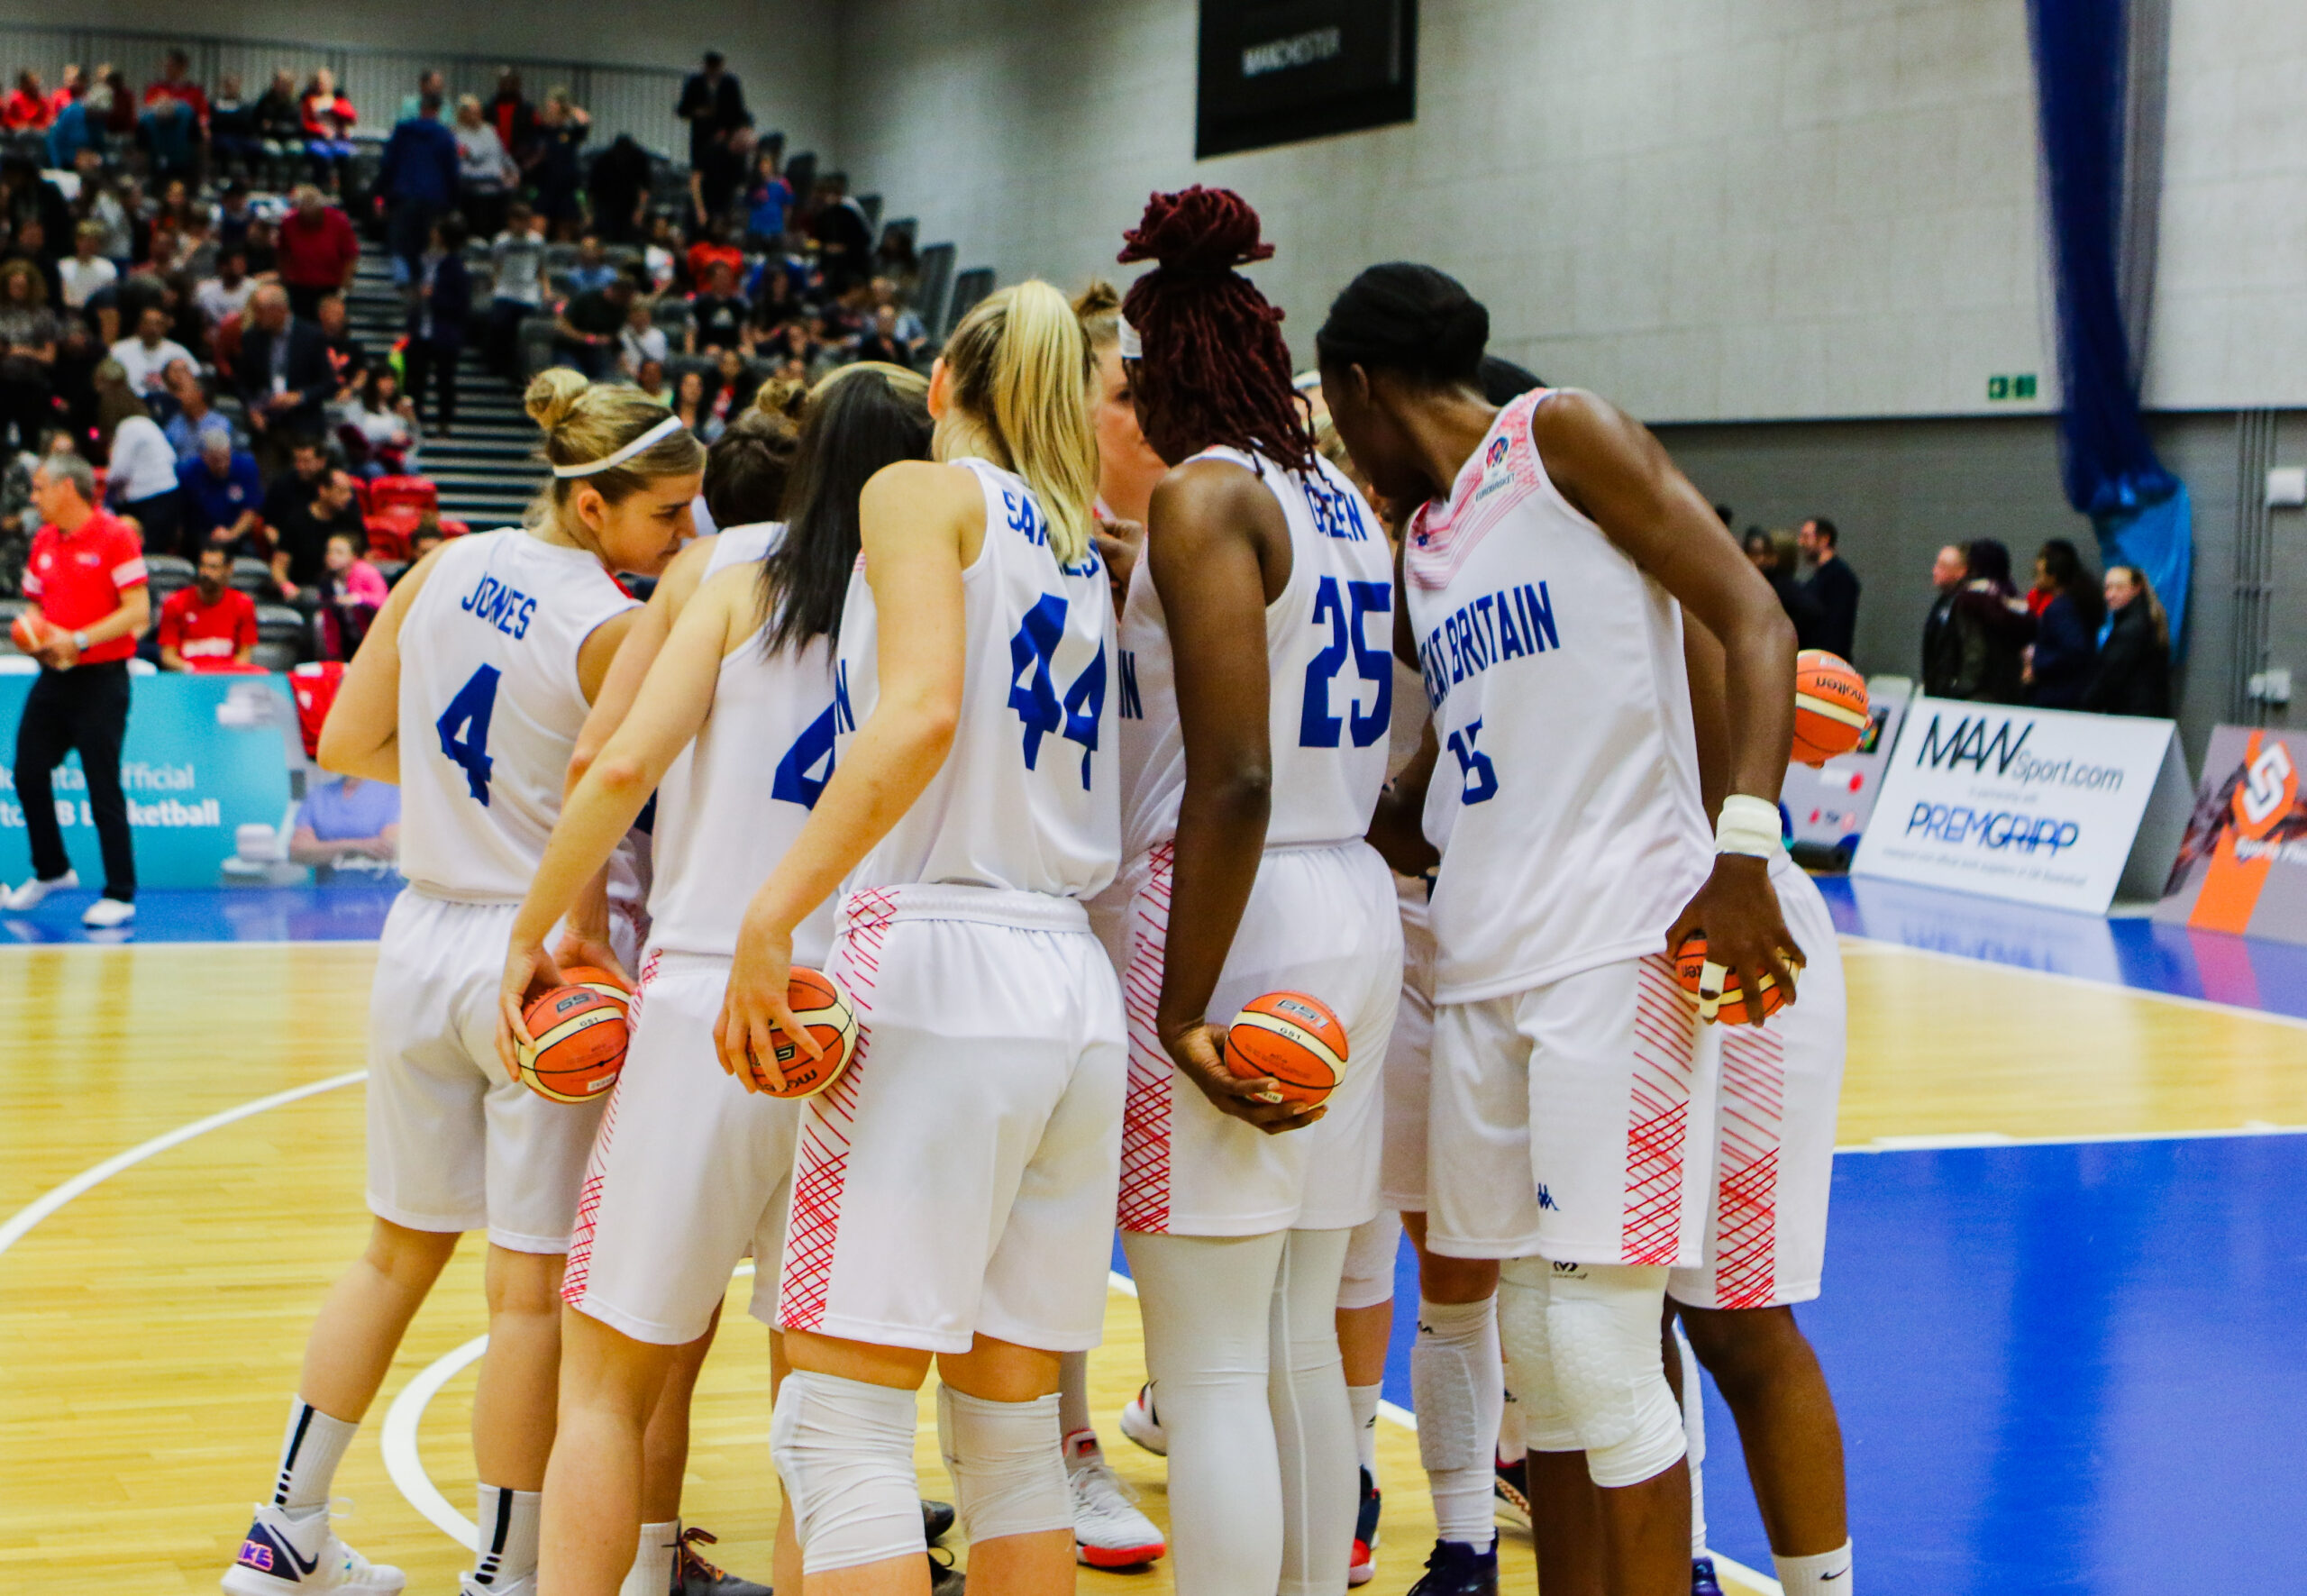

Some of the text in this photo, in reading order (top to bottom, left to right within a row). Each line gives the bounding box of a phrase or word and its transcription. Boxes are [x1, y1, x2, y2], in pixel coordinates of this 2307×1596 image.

[1303, 483, 1368, 542] GEEN
[460, 571, 537, 640] JONES
[1445, 579, 1561, 685] BRITAIN
[1299, 575, 1393, 747] 25
[1816, 676, 1865, 704] molten
[1007, 591, 1108, 791] 44
[436, 662, 502, 807] 4
[1446, 714, 1500, 806] 15
[121, 762, 195, 790] fficial
[80, 798, 220, 826] ketball
[1906, 801, 2079, 858] PREMGRIPP
[579, 1017, 599, 1027] GS1
[1280, 1026, 1300, 1040] GS1
